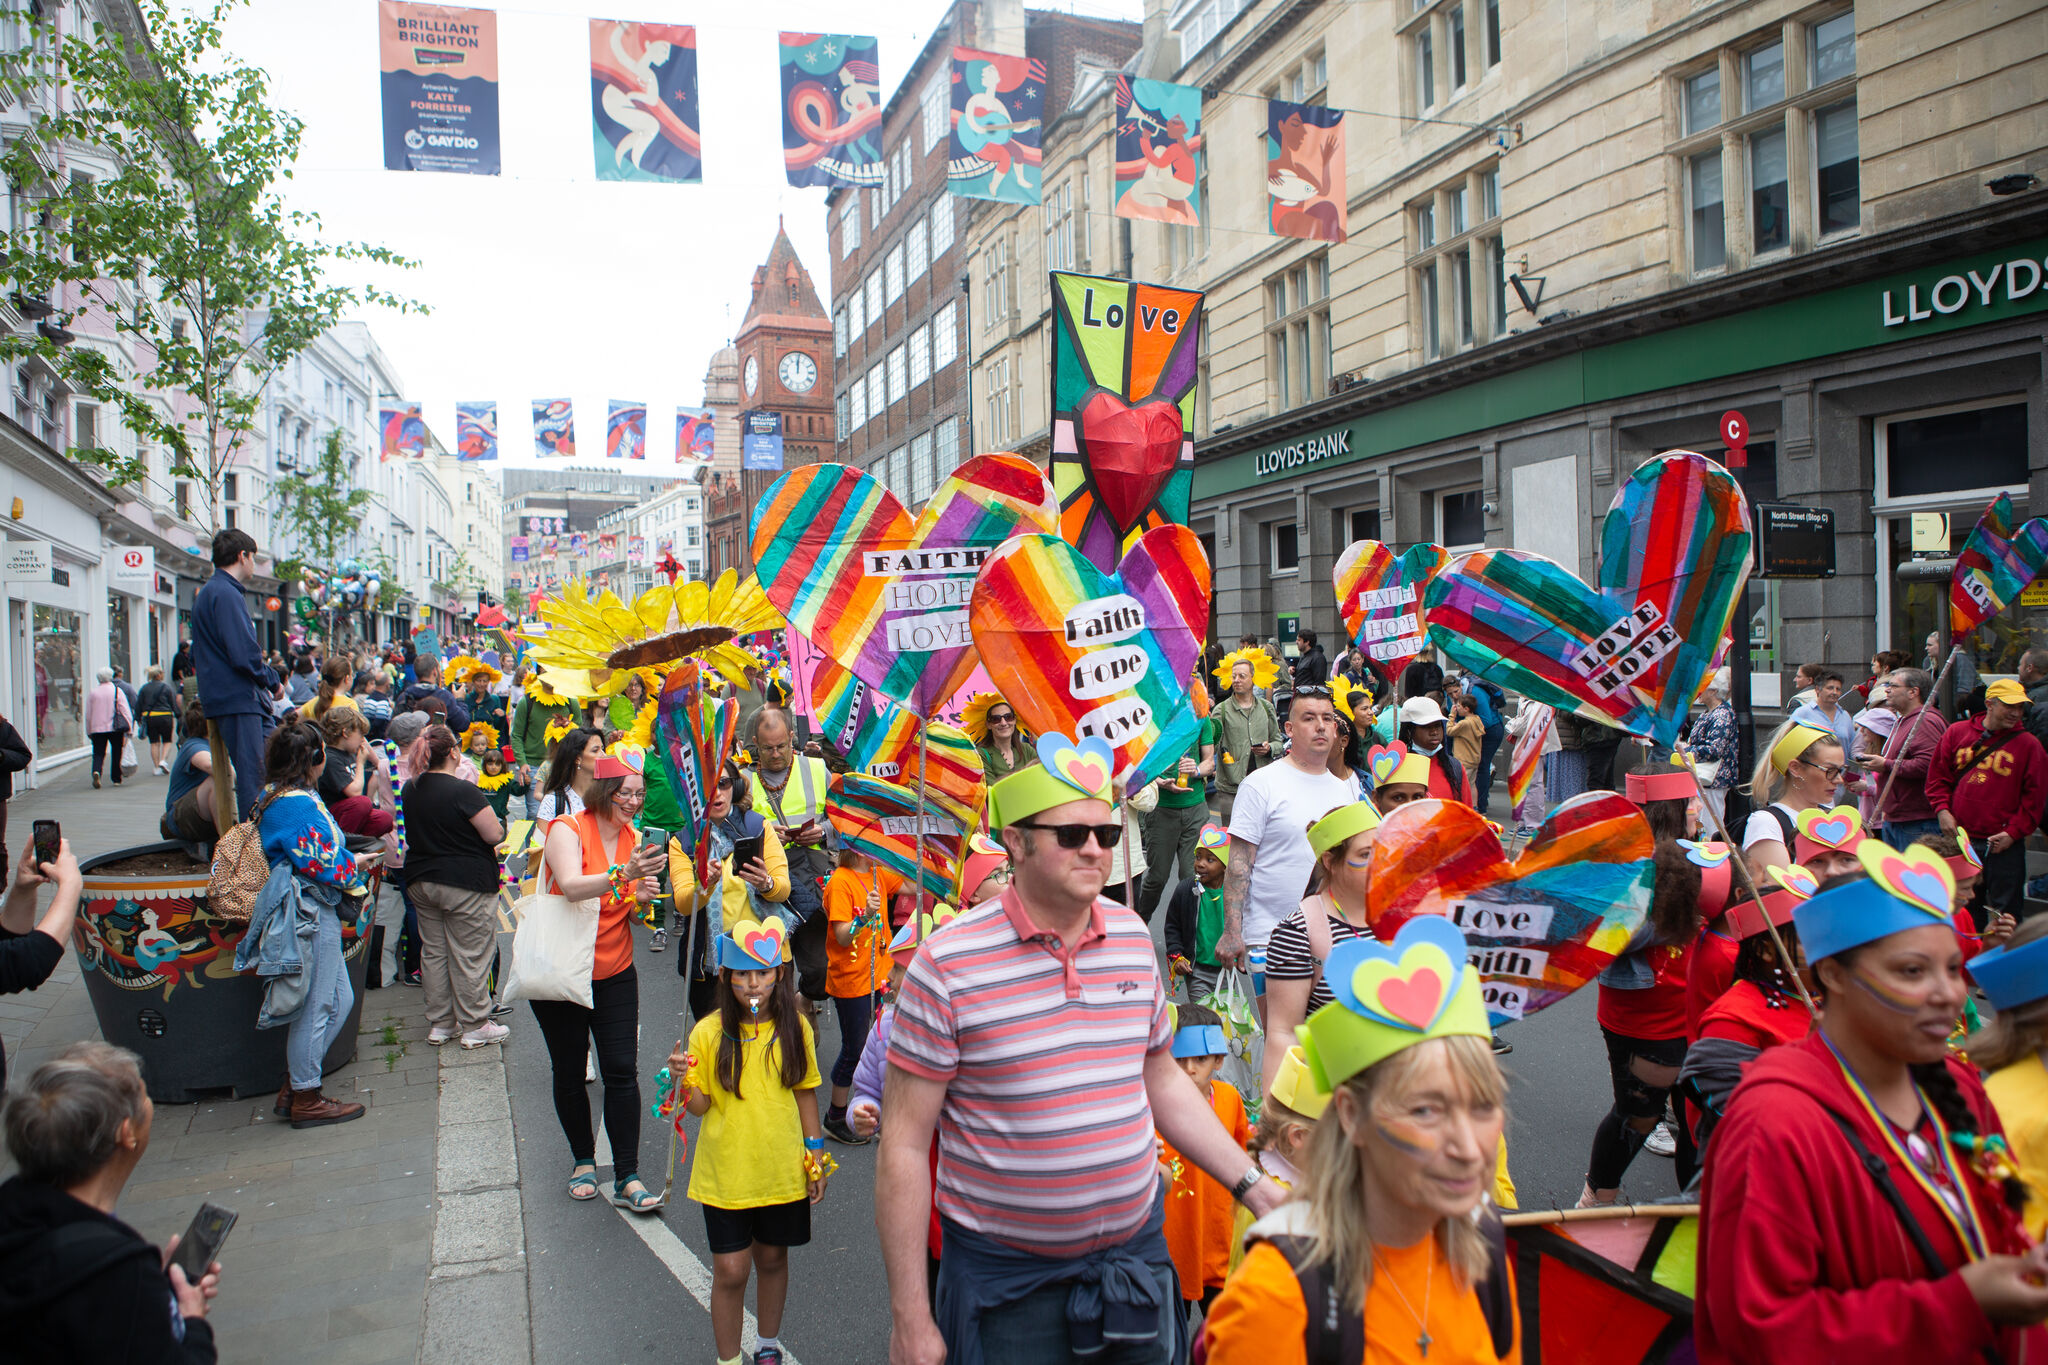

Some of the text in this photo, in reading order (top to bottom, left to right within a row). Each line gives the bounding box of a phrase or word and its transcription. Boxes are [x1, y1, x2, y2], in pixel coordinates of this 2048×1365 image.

[397, 17, 479, 35] BRILLIANT
[399, 31, 479, 48] BRIGHTON
[410, 100, 472, 114] FORRESTER
[427, 92, 455, 102] KATE
[427, 134, 479, 149] GAYDIO
[1883, 256, 2048, 327] LLOYD
[1083, 288, 1180, 335] Love
[1728, 420, 1740, 439] C
[1256, 429, 1350, 476] LLOYDS BANK
[1771, 511, 1788, 520] North
[1788, 512, 1805, 520] Street
[664, 560, 677, 574] 54
[871, 550, 988, 573] FAITH
[891, 580, 971, 609] HOPE
[1365, 585, 1414, 608] FAITH
[894, 621, 973, 650] LOVE
[1065, 607, 1141, 642] Faith
[1370, 615, 1416, 637] HOPE
[1375, 638, 1420, 659] LOVE
[1577, 604, 1657, 672] LOVE
[1595, 625, 1678, 694] HOPE
[1074, 654, 1142, 690] Hope
[844, 684, 864, 746] FAITH
[871, 764, 899, 776] Love
[886, 816, 940, 833] FAIH
[1453, 905, 1531, 931] Love
[1467, 951, 1531, 975] aith
